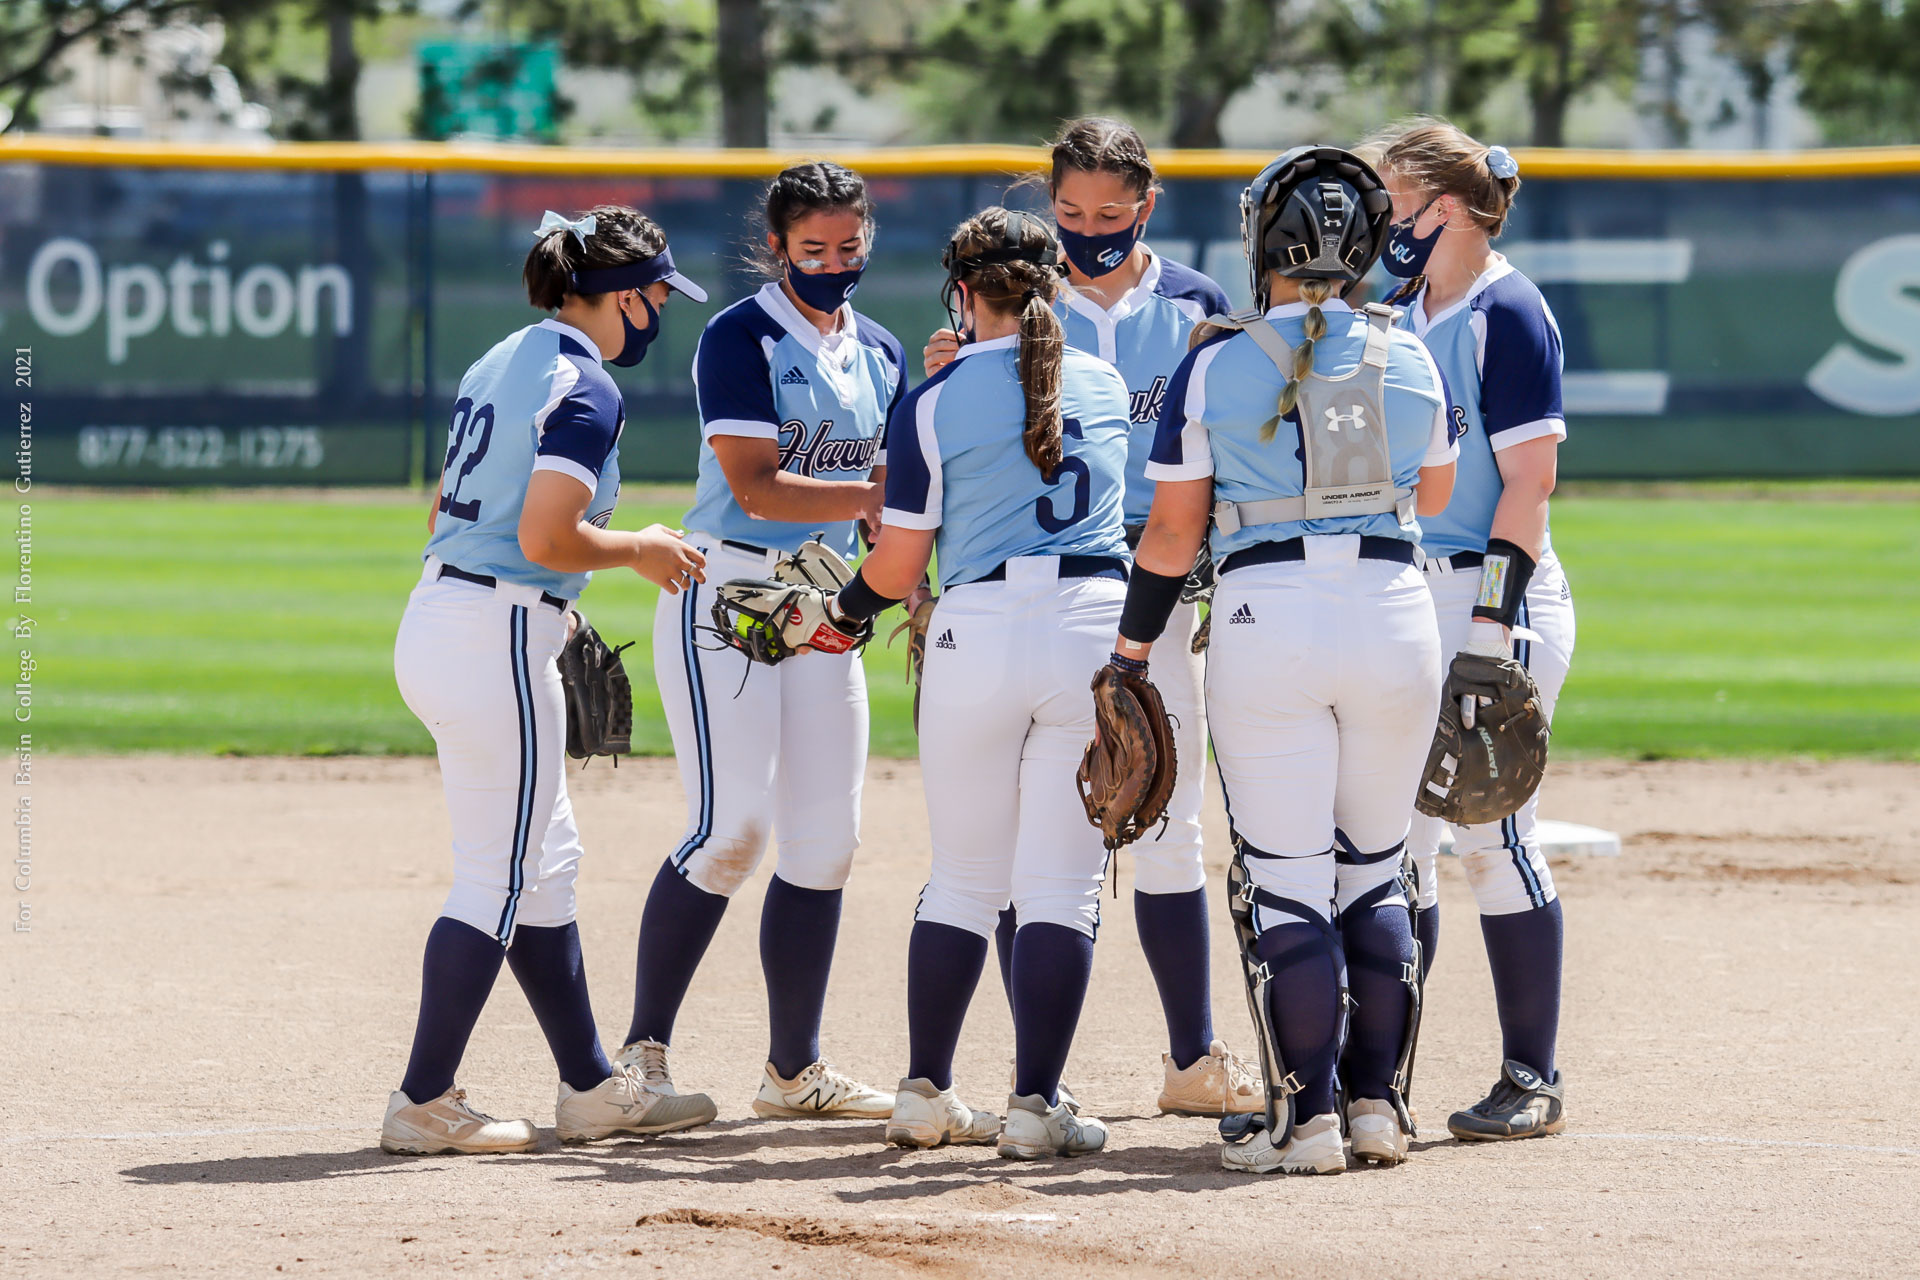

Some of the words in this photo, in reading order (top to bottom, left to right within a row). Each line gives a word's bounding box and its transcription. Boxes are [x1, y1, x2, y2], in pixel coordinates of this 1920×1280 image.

[27, 236, 353, 364] Option
[780, 378, 809, 386] adidas
[439, 397, 495, 522] 22
[1036, 418, 1090, 535] 5
[1321, 493, 1348, 501] UNDER
[1350, 490, 1381, 499] ARMOUR
[1229, 615, 1256, 625] adidas
[935, 640, 957, 650] adidas
[1476, 726, 1499, 778] EASTON
